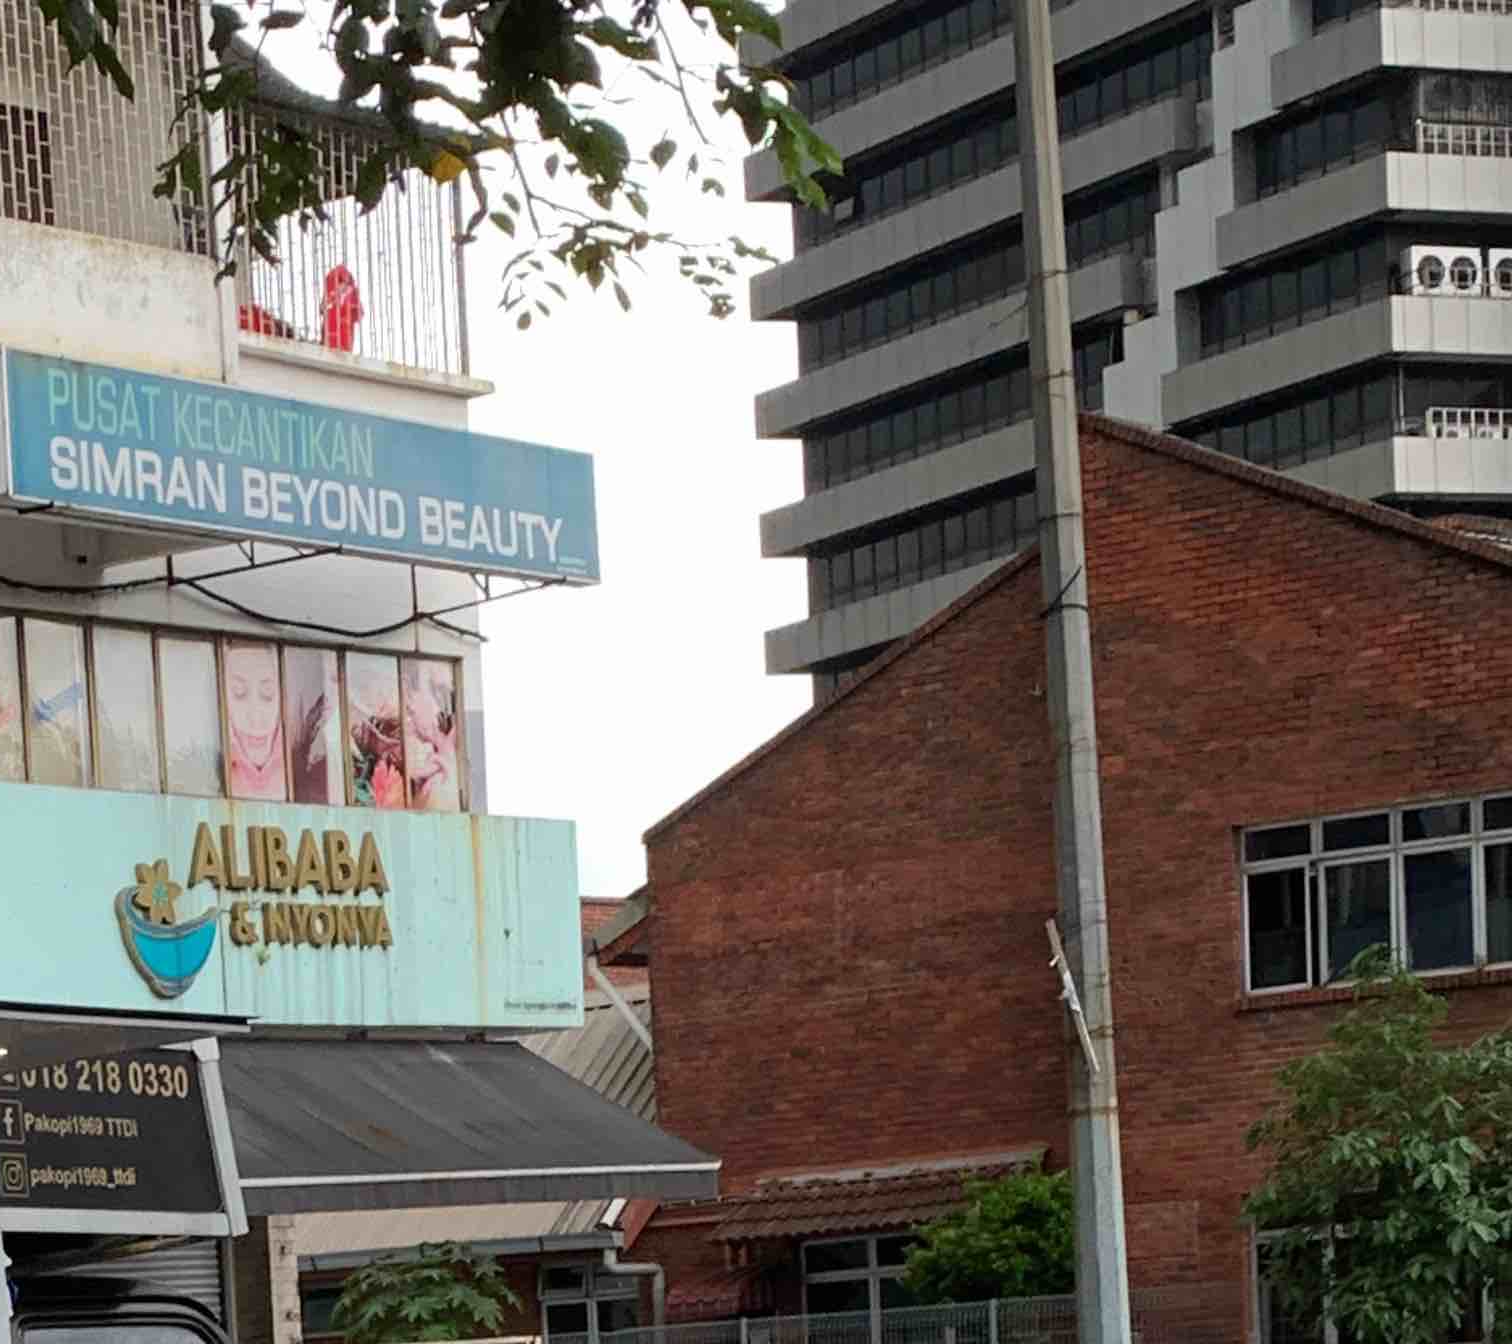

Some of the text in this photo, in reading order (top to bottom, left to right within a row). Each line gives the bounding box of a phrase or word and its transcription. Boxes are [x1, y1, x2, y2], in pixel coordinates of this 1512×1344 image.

[48, 366, 375, 479] PUSAT KECANTIKAN
[47, 435, 563, 562] SIMRAN BEYOND BEAUTY
[187, 821, 390, 897] ALIBABA
[229, 901, 394, 949] & NYONYA
[75, 1058, 122, 1094] 218
[128, 1060, 190, 1099] 0330
